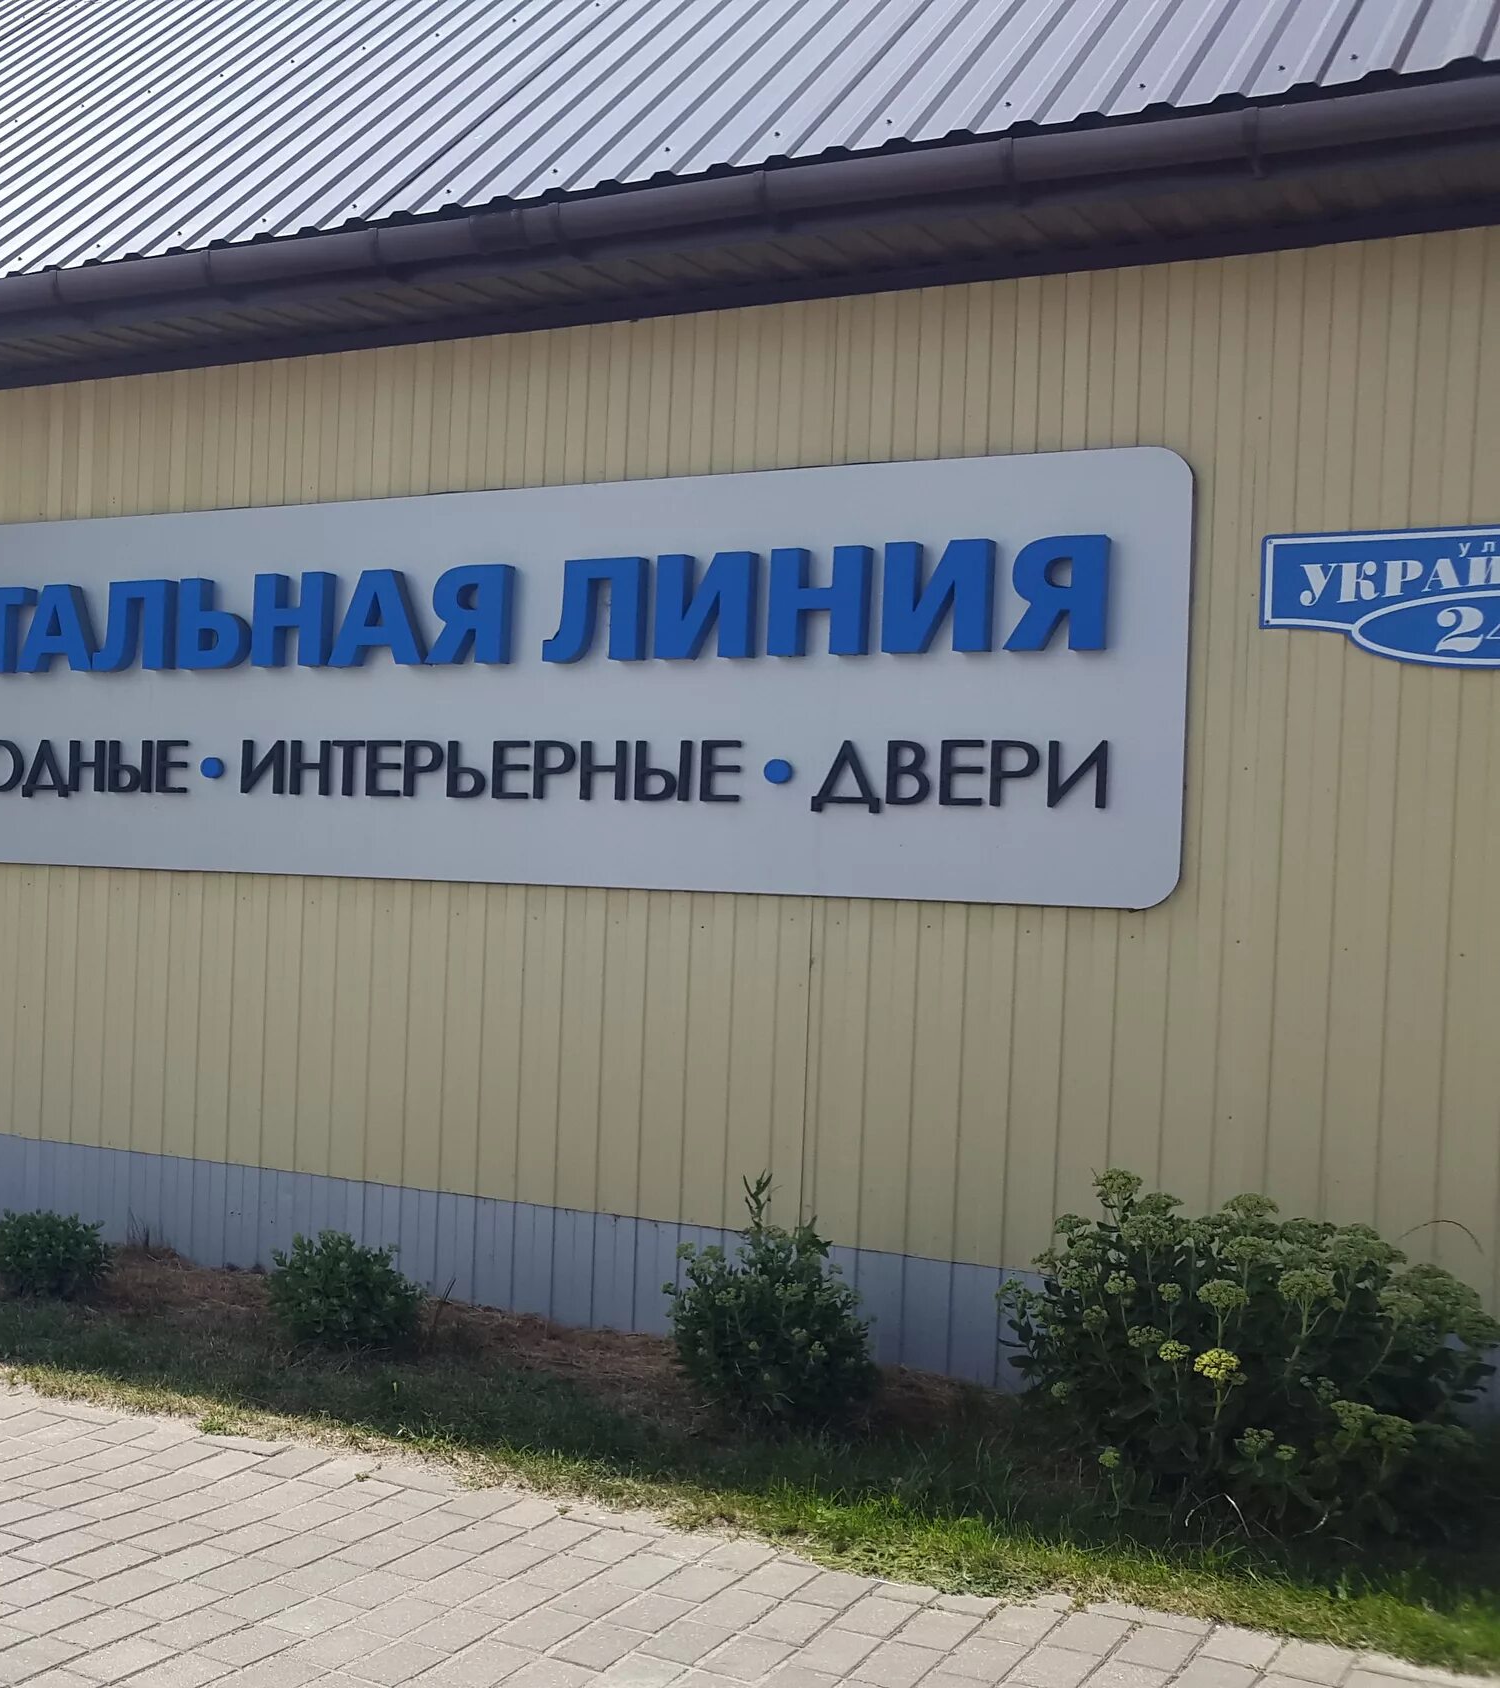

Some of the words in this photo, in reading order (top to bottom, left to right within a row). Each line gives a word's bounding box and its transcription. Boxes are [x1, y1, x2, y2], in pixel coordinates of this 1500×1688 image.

[542, 534, 1112, 664] ЛИНИЯ
[240, 739, 742, 802] ИНТЕРЬЕРНЫЕ
[811, 739, 1108, 814] ДВЕРИ
